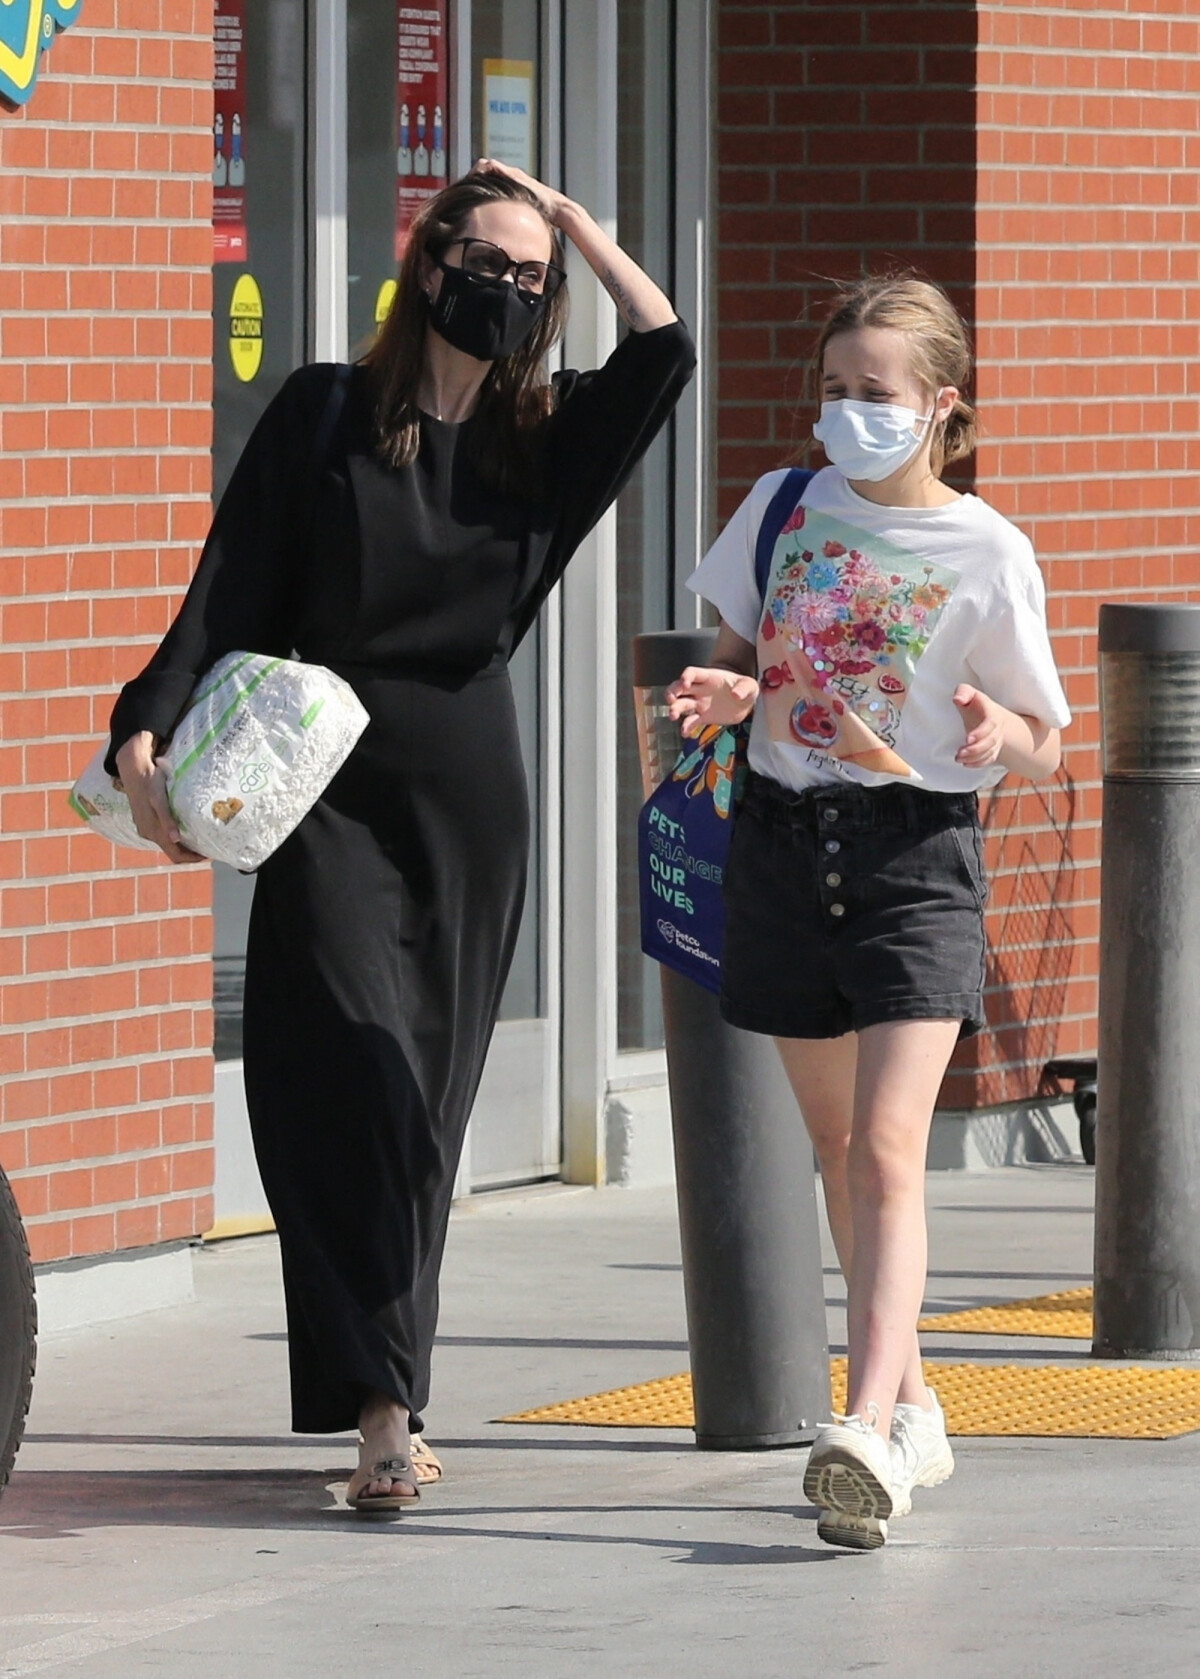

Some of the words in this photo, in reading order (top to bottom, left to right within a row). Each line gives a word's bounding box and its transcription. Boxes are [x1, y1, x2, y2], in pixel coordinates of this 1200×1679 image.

[231, 318, 261, 336] CAUTION
[648, 831, 722, 885] CHANGE
[650, 853, 685, 886] OUR
[651, 874, 694, 915] LIVES
